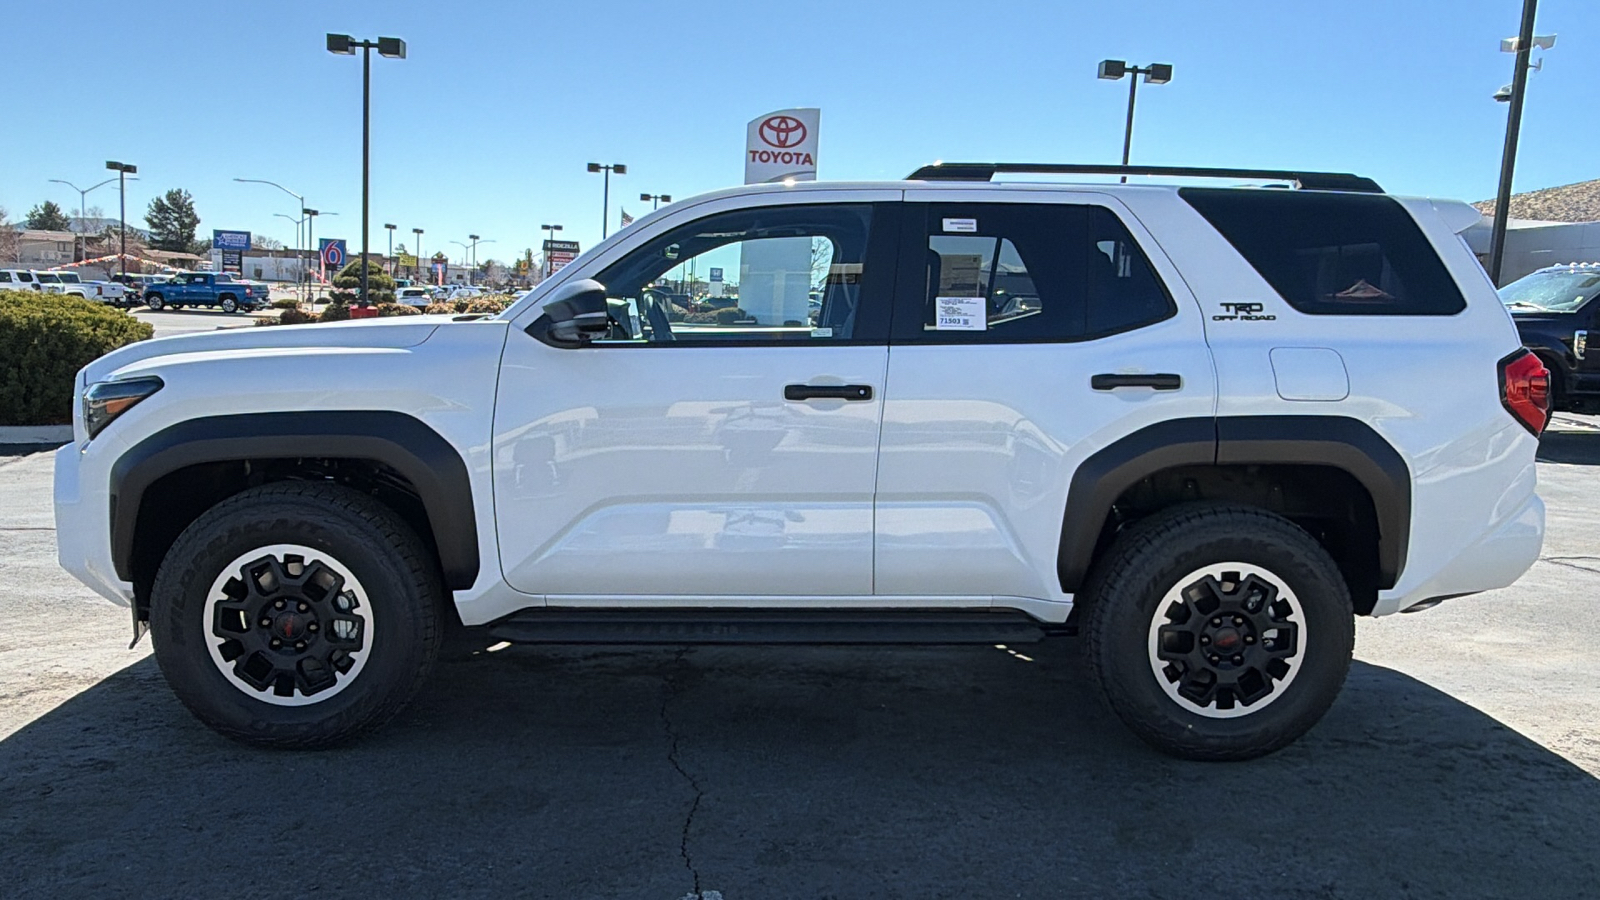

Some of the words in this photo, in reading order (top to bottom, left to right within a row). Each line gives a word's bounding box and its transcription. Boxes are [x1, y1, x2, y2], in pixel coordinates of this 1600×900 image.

[749, 150, 813, 165] TOYOTA
[325, 241, 342, 264] 6
[1220, 303, 1263, 315] TRD
